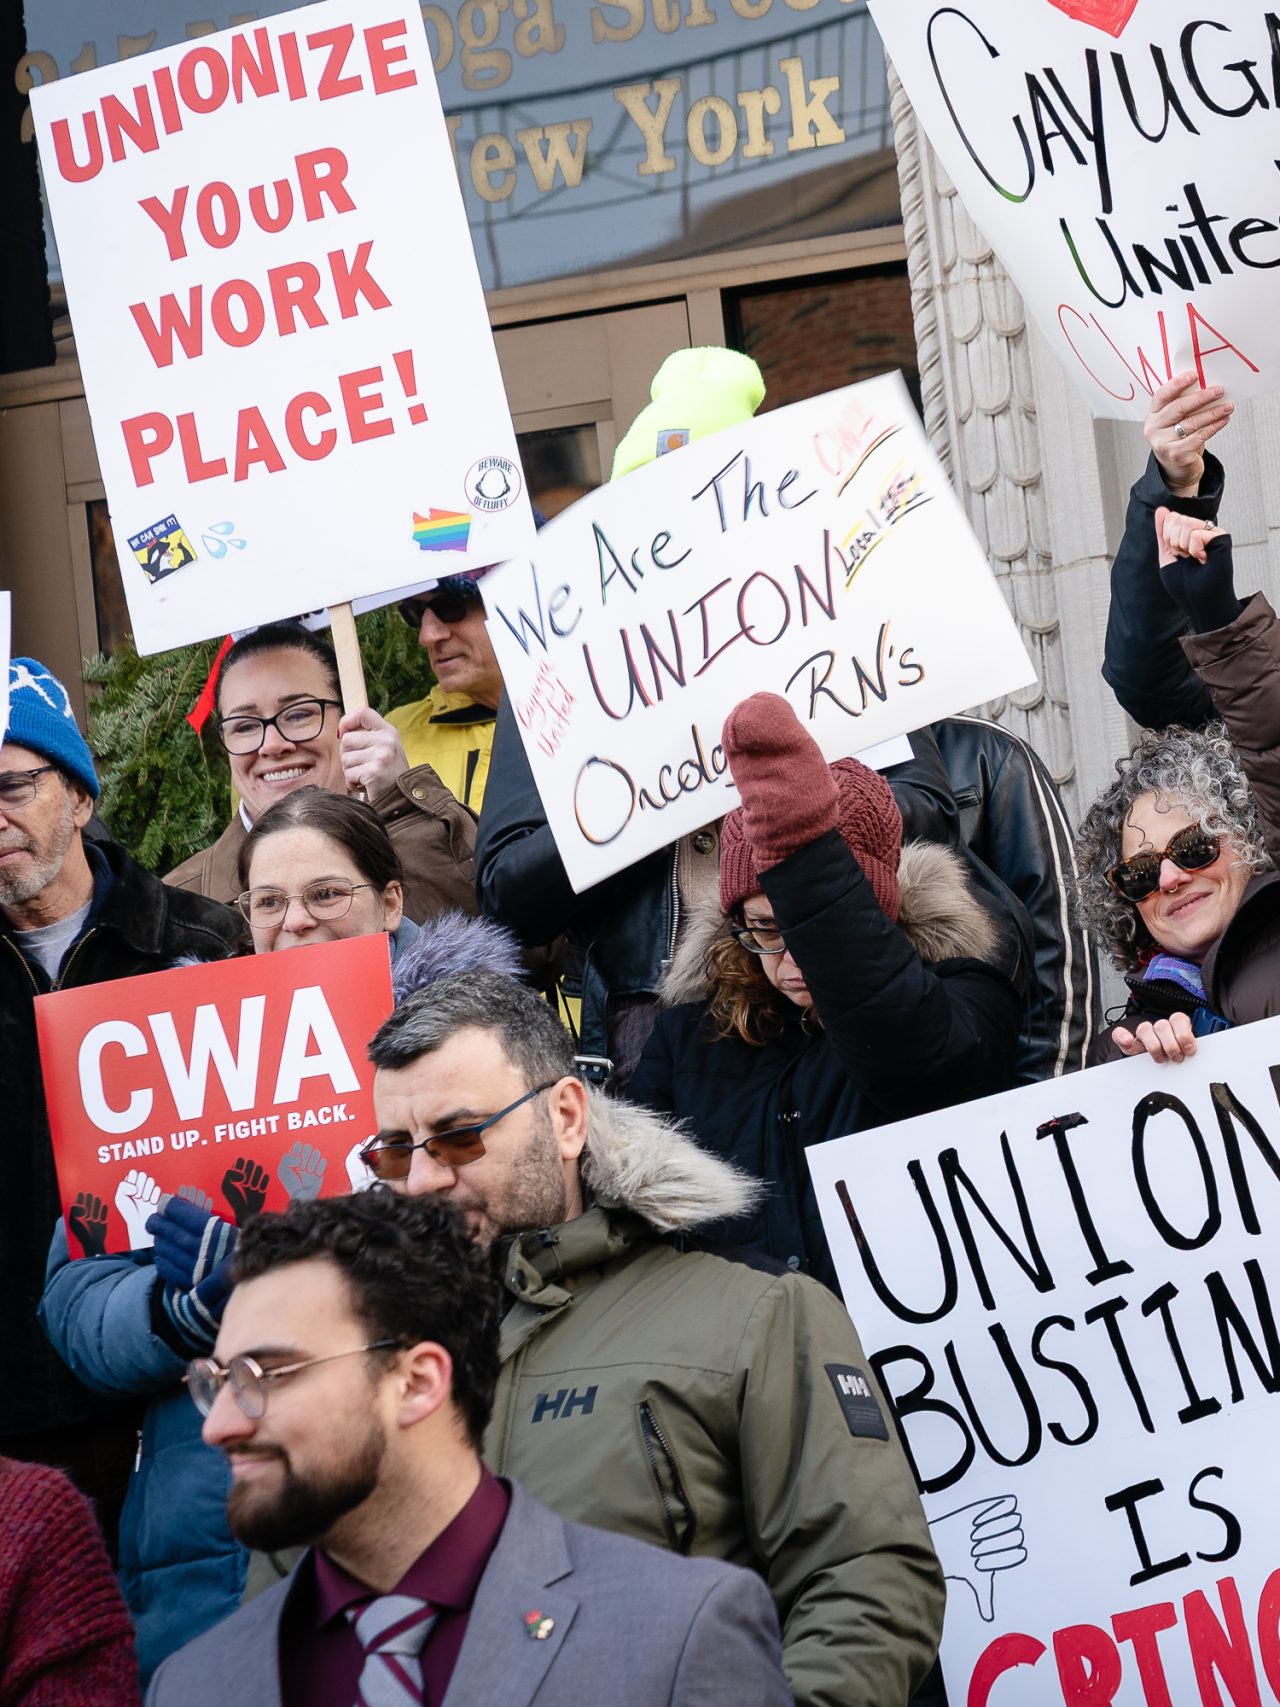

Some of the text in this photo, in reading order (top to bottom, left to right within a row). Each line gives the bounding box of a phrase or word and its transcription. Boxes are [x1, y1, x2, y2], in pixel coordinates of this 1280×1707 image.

[50, 19, 418, 184] UNIONIZE
[446, 56, 846, 203] ew York
[129, 240, 393, 368] WORK
[1058, 302, 1260, 401] CWA
[120, 349, 429, 488] PLACE!
[478, 457, 513, 475] BEWARE
[473, 495, 483, 507] OF
[495, 562, 583, 657] We
[592, 520, 693, 606] Are
[691, 449, 819, 534] The
[582, 528, 837, 720] UNION
[786, 620, 925, 720] RN's
[78, 985, 362, 1134] CWA
[98, 1103, 356, 1164] STAND UP. FIGHT BACK.
[531, 1385, 600, 1423] HH
[837, 1374, 871, 1398] HH
[1105, 1466, 1242, 1587] IS
